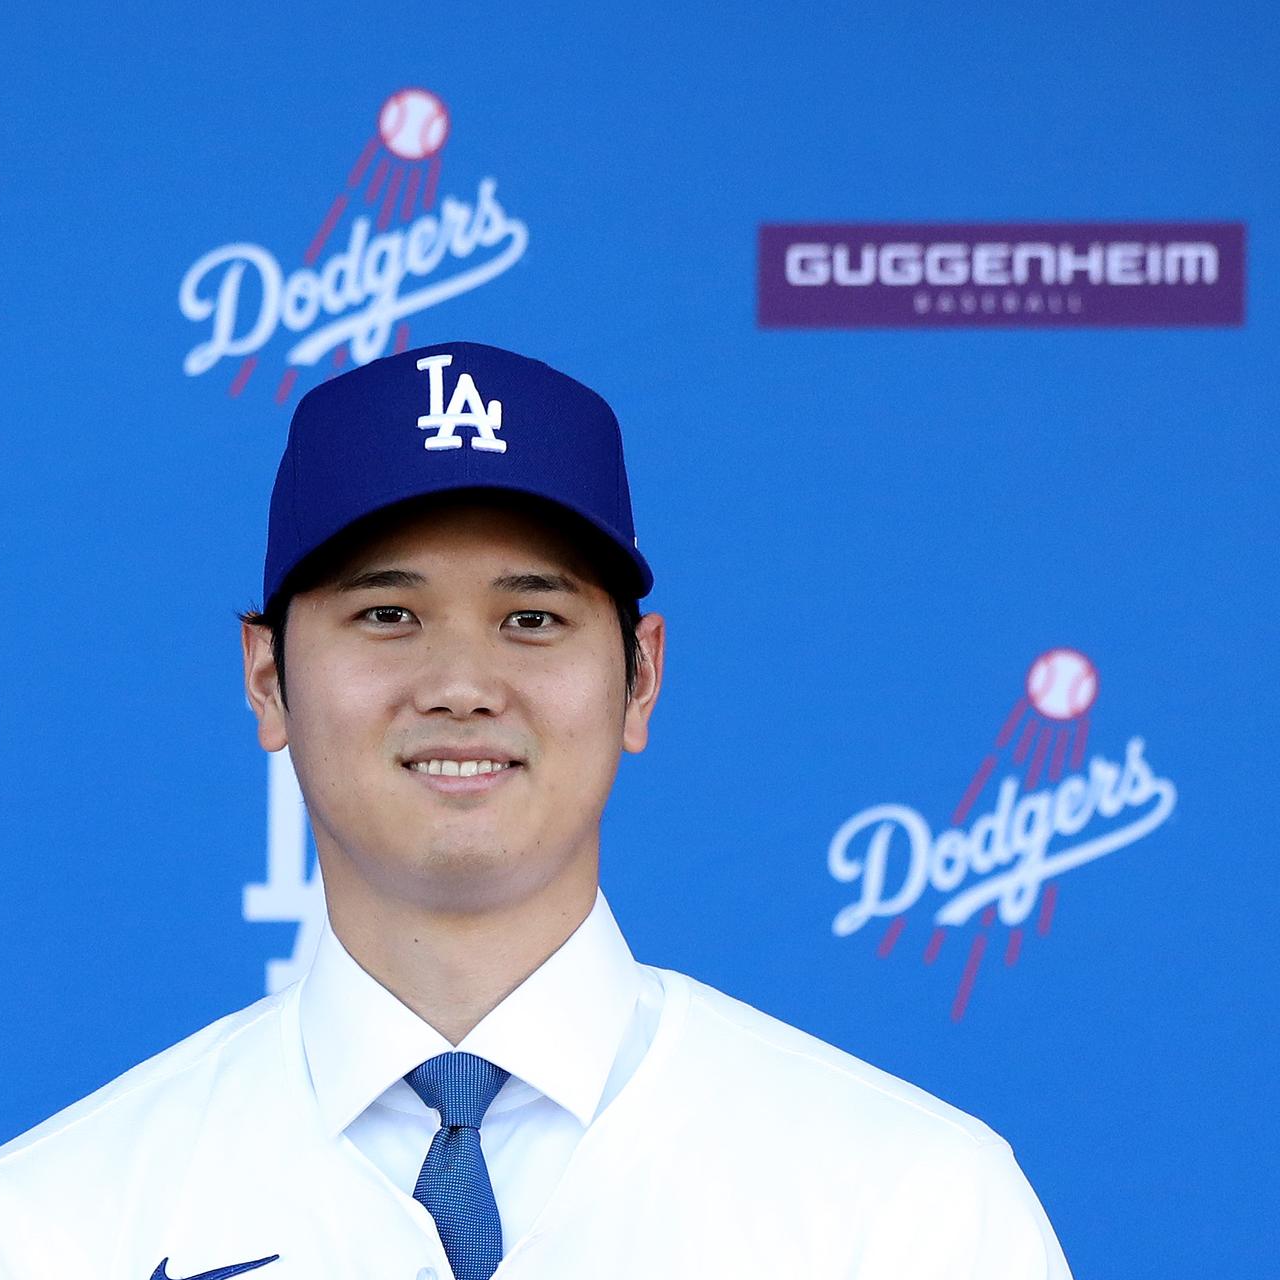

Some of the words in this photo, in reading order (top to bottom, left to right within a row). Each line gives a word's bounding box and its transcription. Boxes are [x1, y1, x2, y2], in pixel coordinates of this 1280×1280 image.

[178, 179, 529, 377] Dodgers
[785, 243, 1218, 287] GUGGENHEIM
[416, 354, 507, 454] LA
[826, 737, 1178, 937] Dodgers
